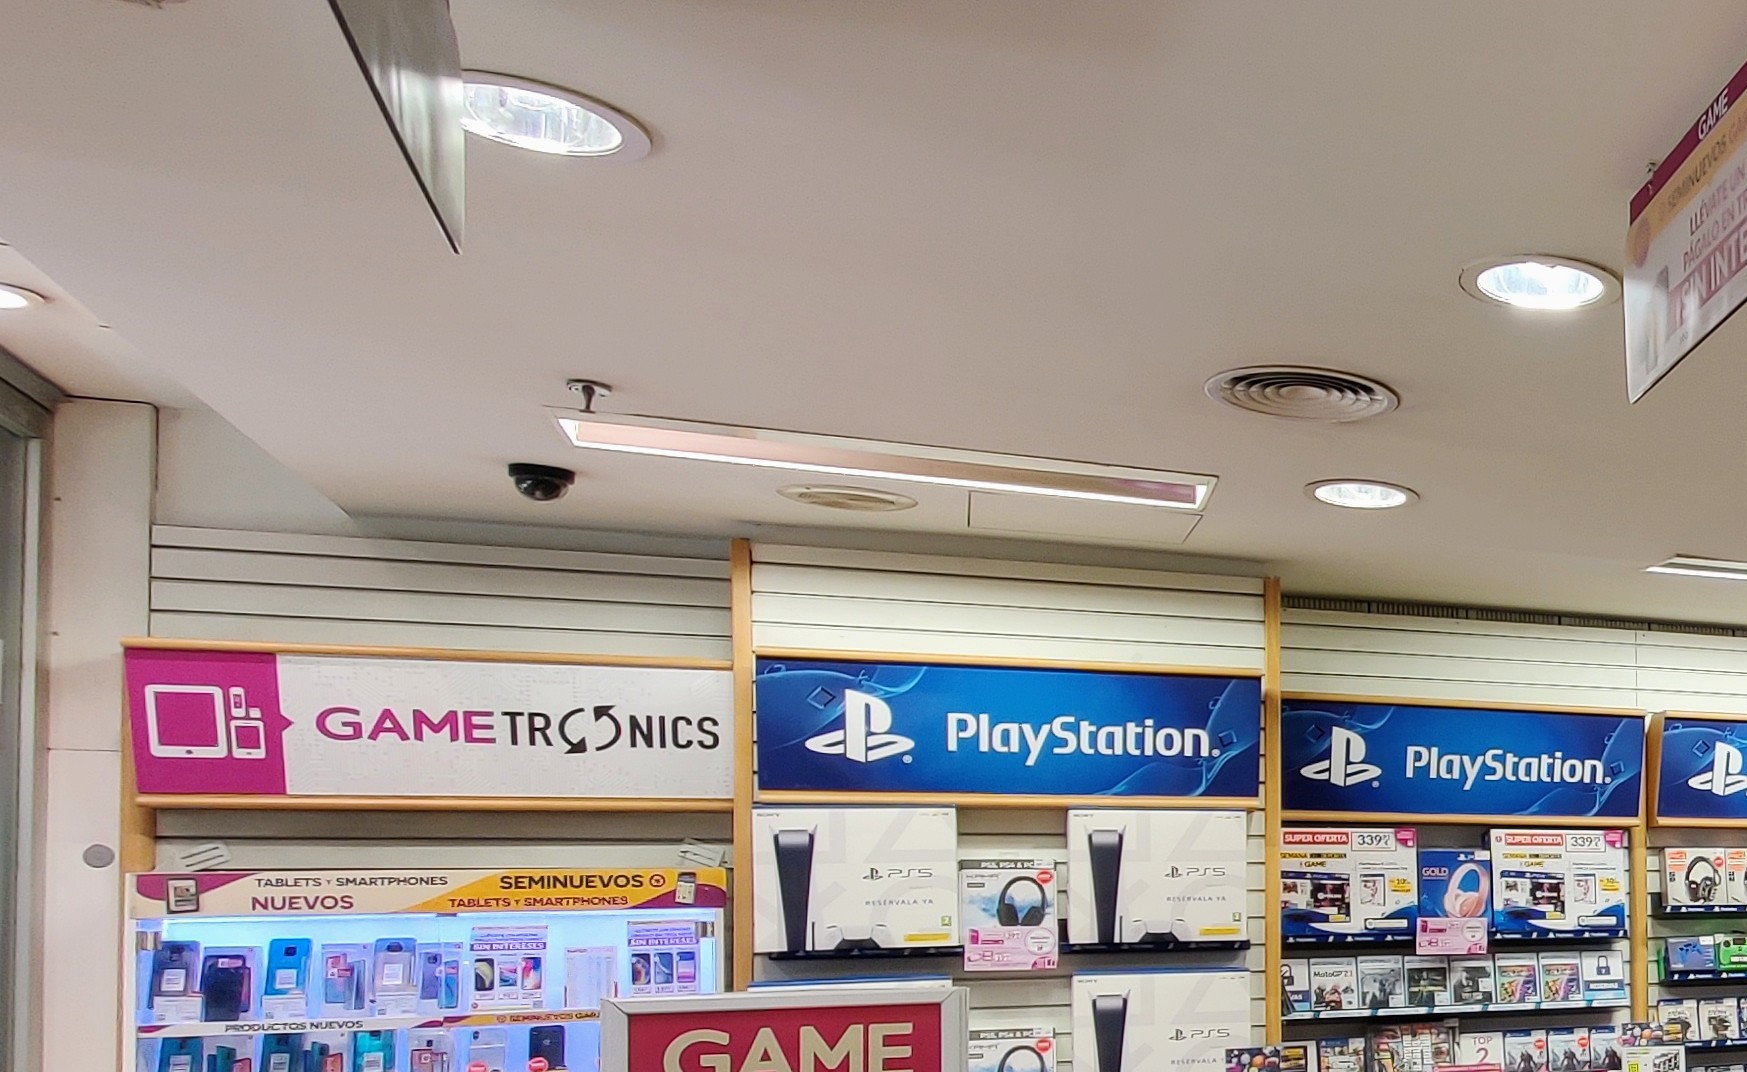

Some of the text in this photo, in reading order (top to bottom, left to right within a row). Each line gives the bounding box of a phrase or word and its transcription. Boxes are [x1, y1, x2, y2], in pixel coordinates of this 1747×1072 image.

[1698, 88, 1728, 141] GAME
[1729, 163, 1745, 195] UN
[1721, 205, 1735, 234] EN
[1679, 274, 1709, 325] SIN
[945, 711, 1220, 766] PlayStation
[1405, 745, 1611, 791] PlayStation
[255, 876, 448, 888] TABLETS SMARTPHONES
[500, 875, 645, 890] SEMINUEVOS
[1422, 867, 1448, 876] GOLD
[251, 895, 354, 911] NUEVOS
[450, 896, 628, 908] TABLETS SMARTPHONES
[225, 1020, 363, 1032] PRODUCTOS NUEVOS
